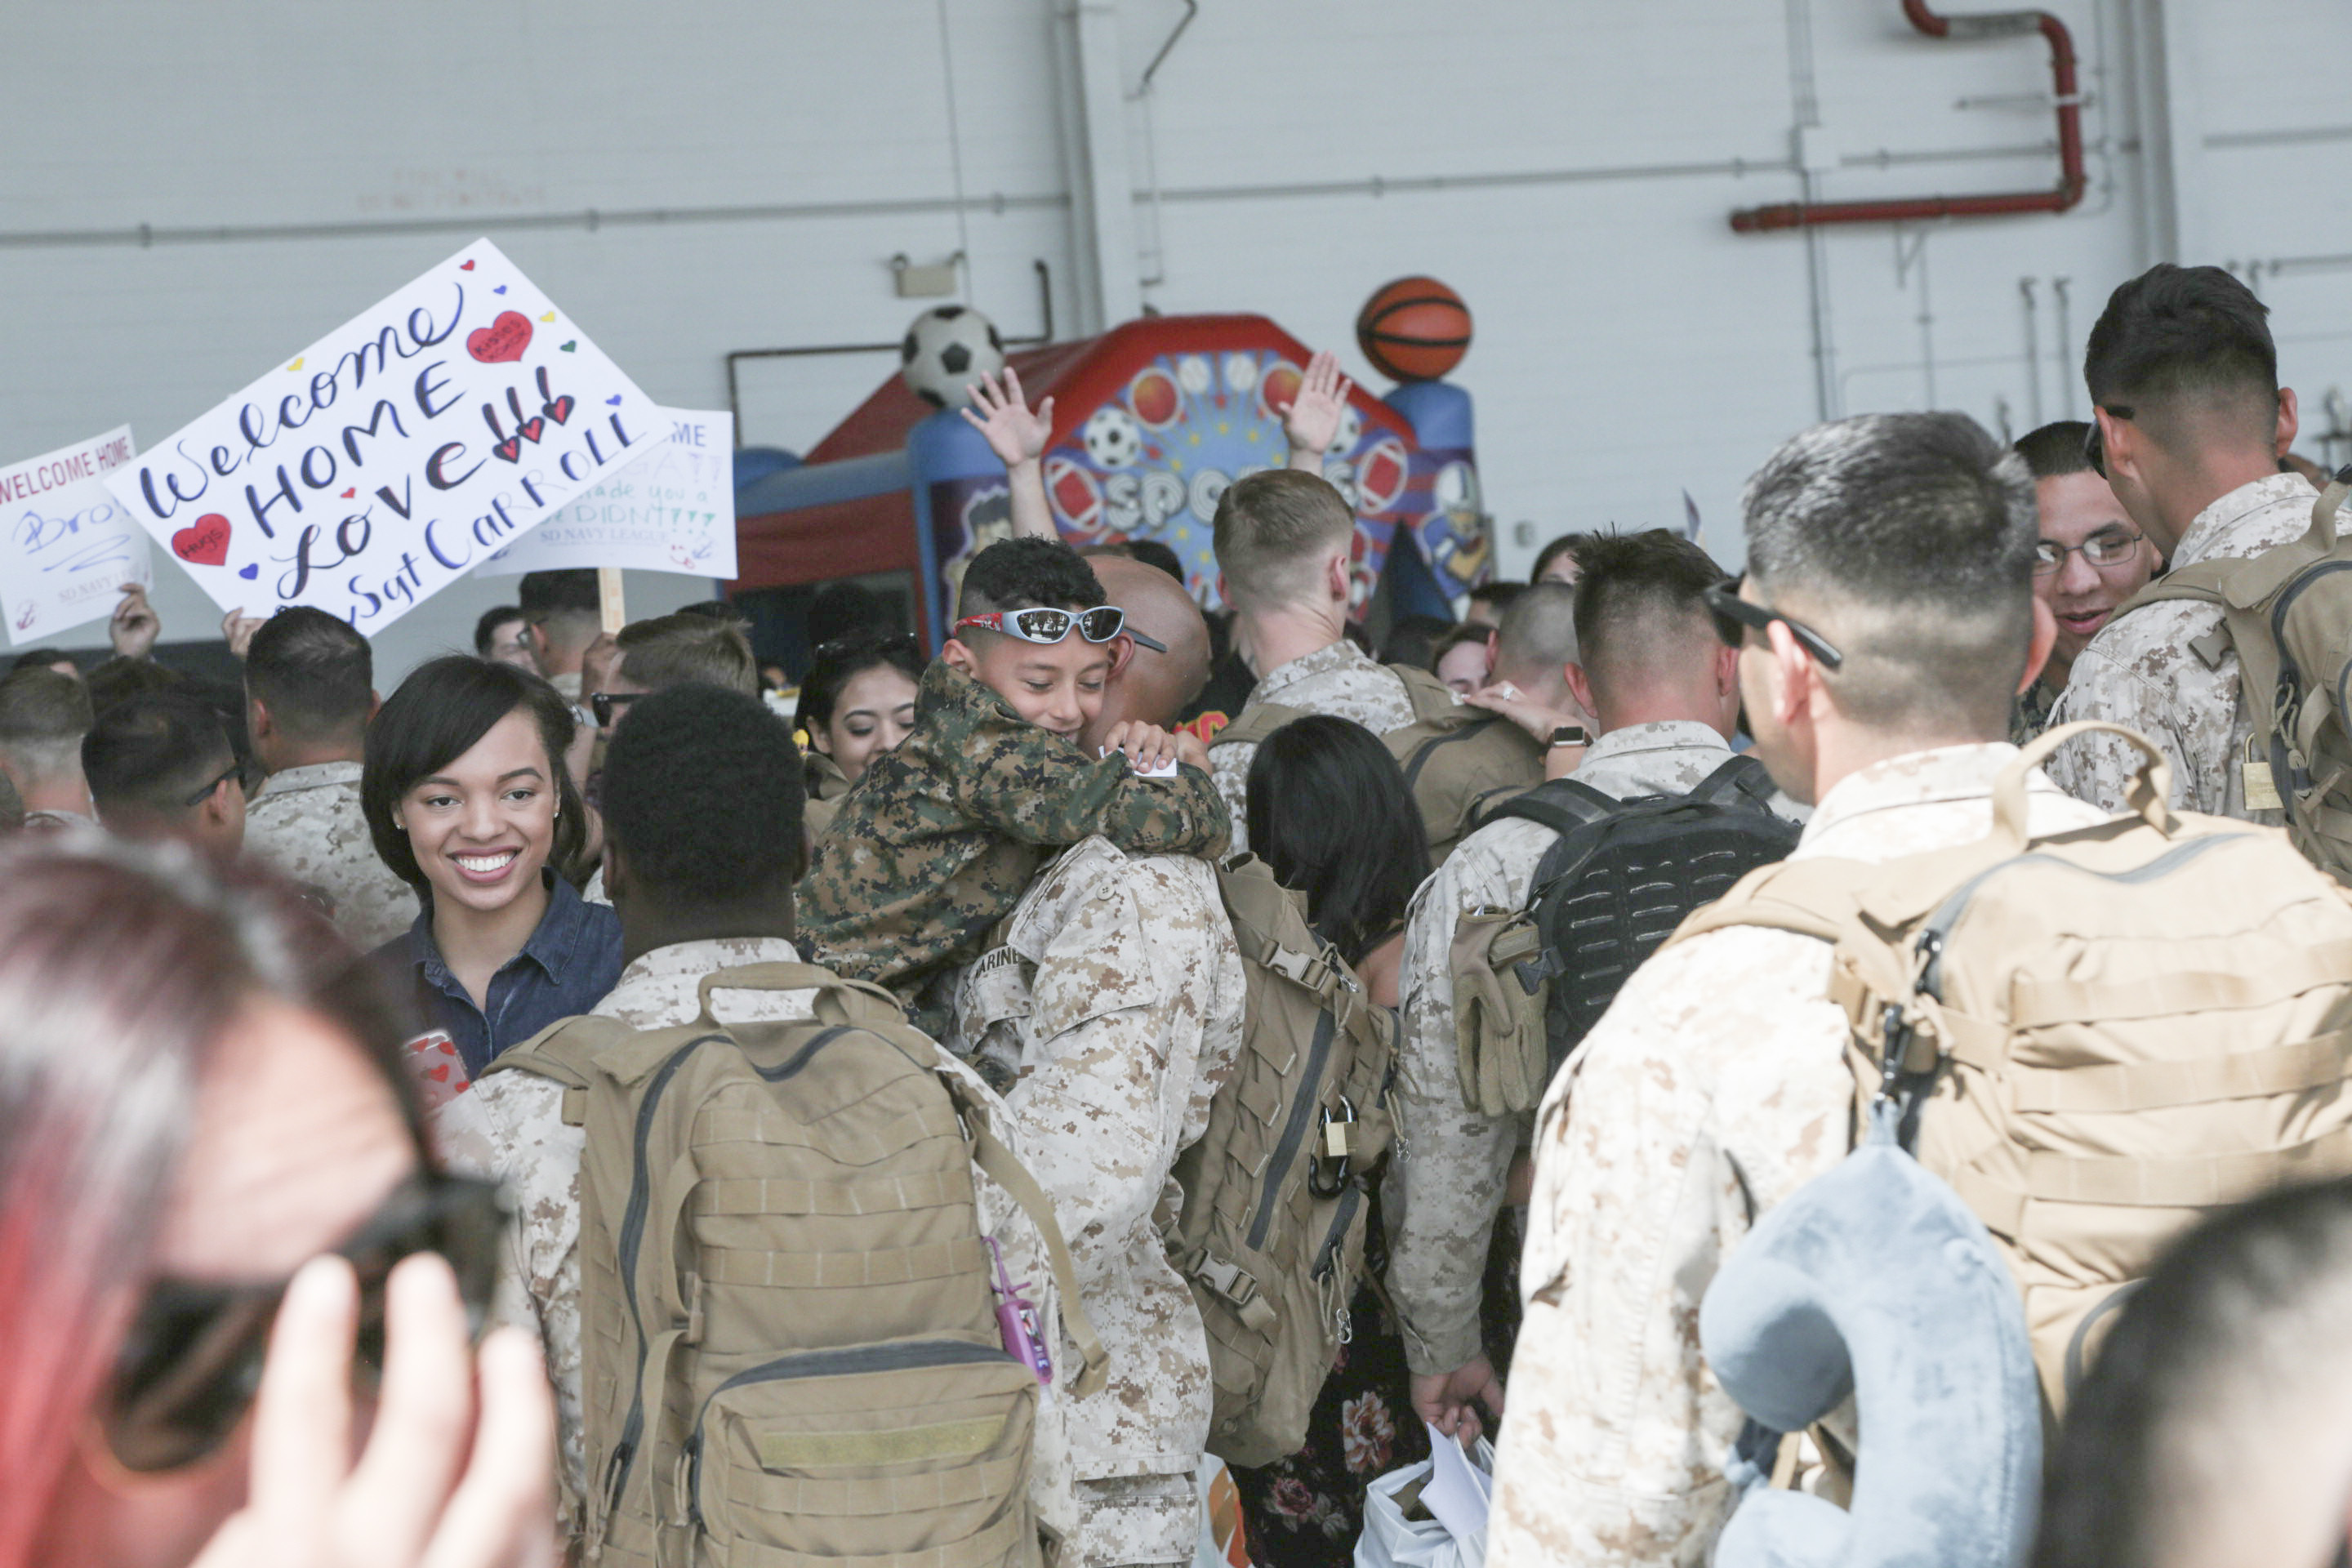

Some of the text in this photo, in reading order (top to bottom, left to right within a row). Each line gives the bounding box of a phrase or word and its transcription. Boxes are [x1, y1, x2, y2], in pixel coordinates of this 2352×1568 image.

[140, 282, 464, 519] Welcome
[96, 436, 131, 471] HOME
[245, 360, 468, 539] HOME
[564, 528, 605, 541] NAVY
[609, 528, 670, 543] LEAGUE
[349, 552, 421, 618] Sgt
